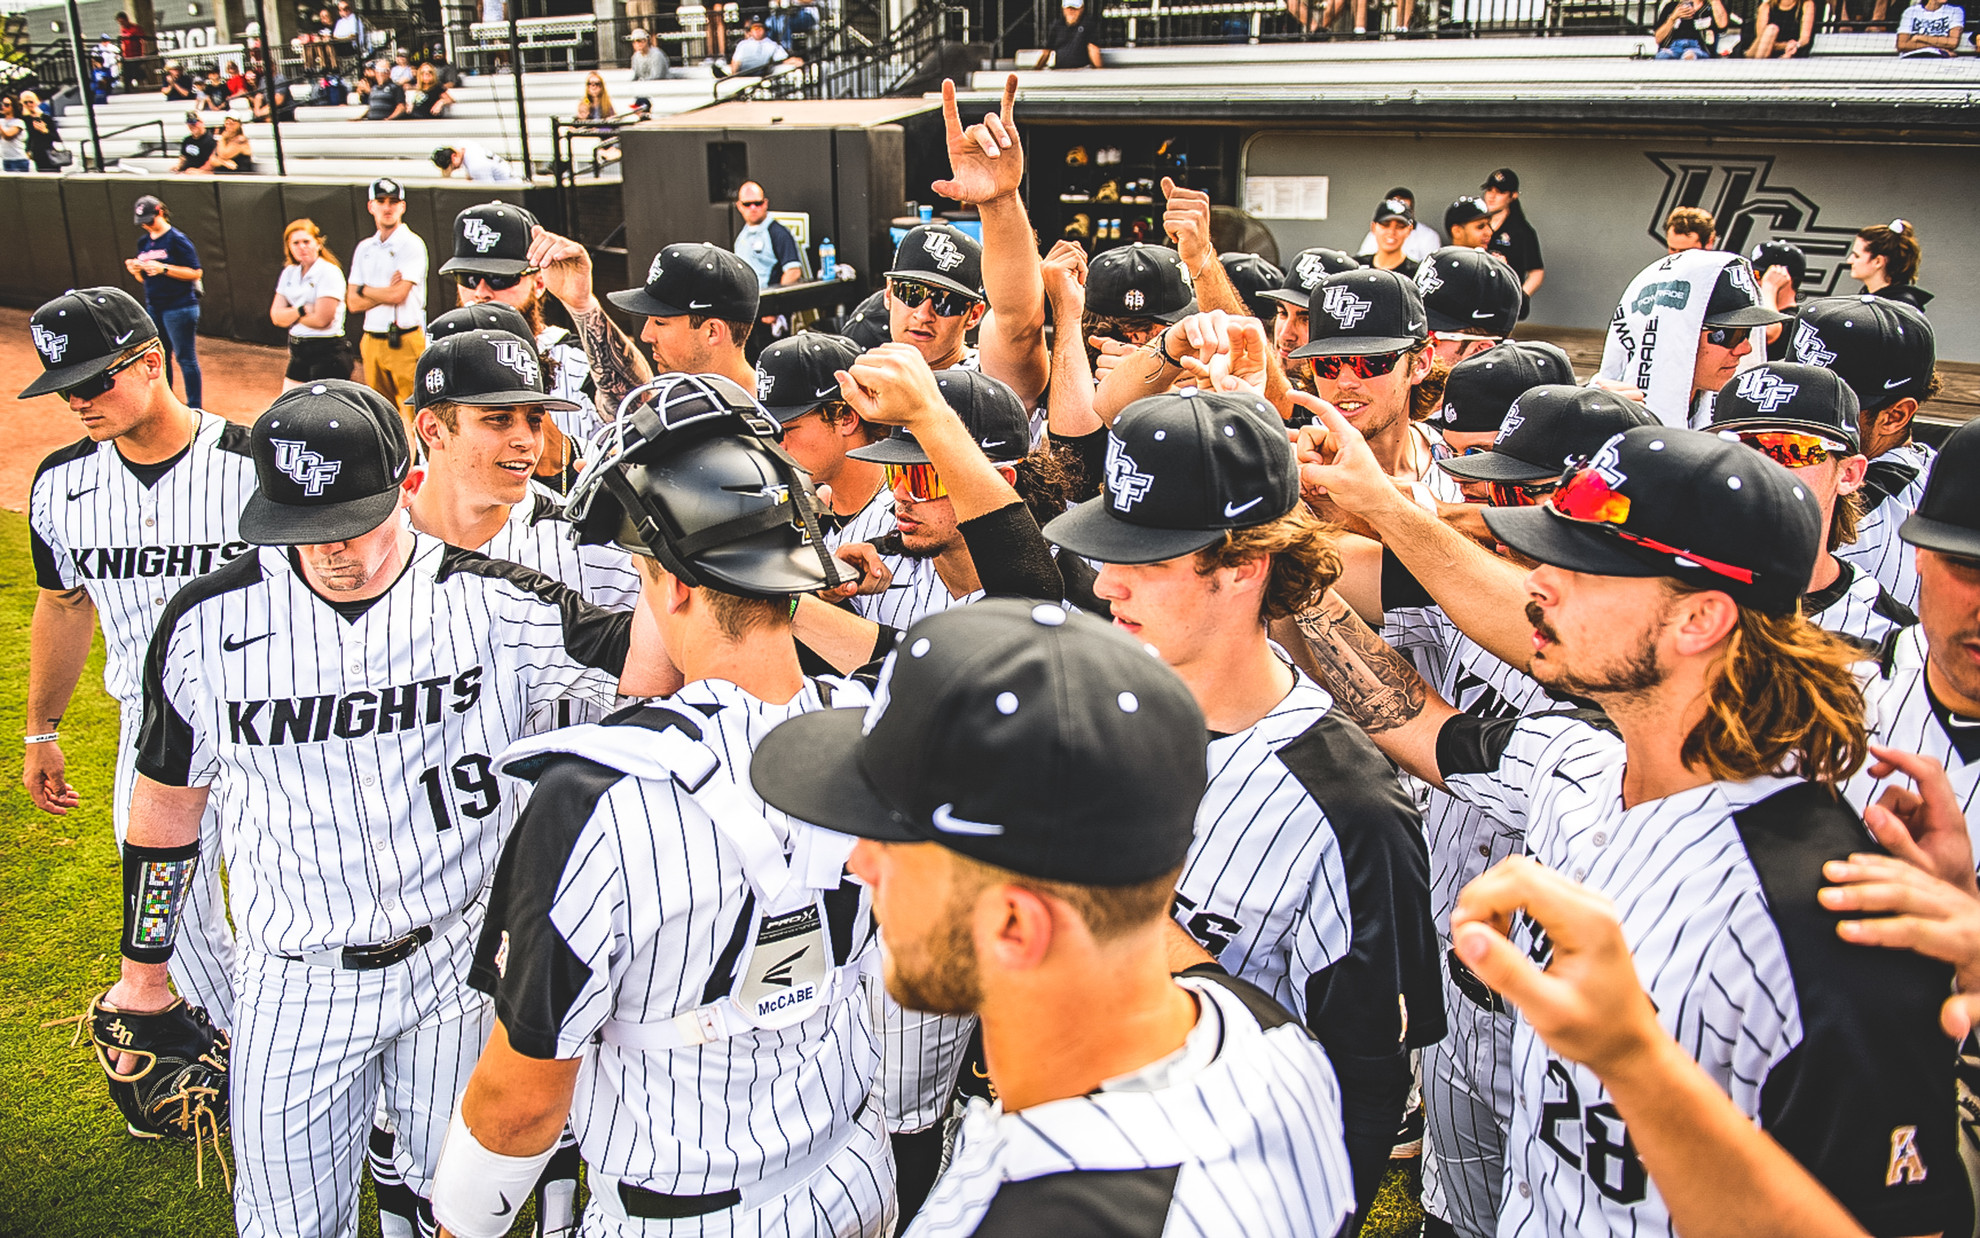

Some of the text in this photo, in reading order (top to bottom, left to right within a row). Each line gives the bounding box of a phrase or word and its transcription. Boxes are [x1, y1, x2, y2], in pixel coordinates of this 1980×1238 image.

[463, 219, 501, 252] UCF
[922, 231, 965, 272] UCF
[1322, 285, 1372, 330] UCF
[30, 324, 68, 363] UCF
[488, 340, 540, 386] UCF
[1736, 367, 1799, 412] UCF
[269, 438, 342, 496] UCF
[69, 541, 249, 579] KNIGHTS
[226, 665, 483, 746] KNIGHTS
[419, 753, 502, 833] 19
[758, 986, 814, 1016] McCABE
[1539, 1058, 1648, 1206] 28
